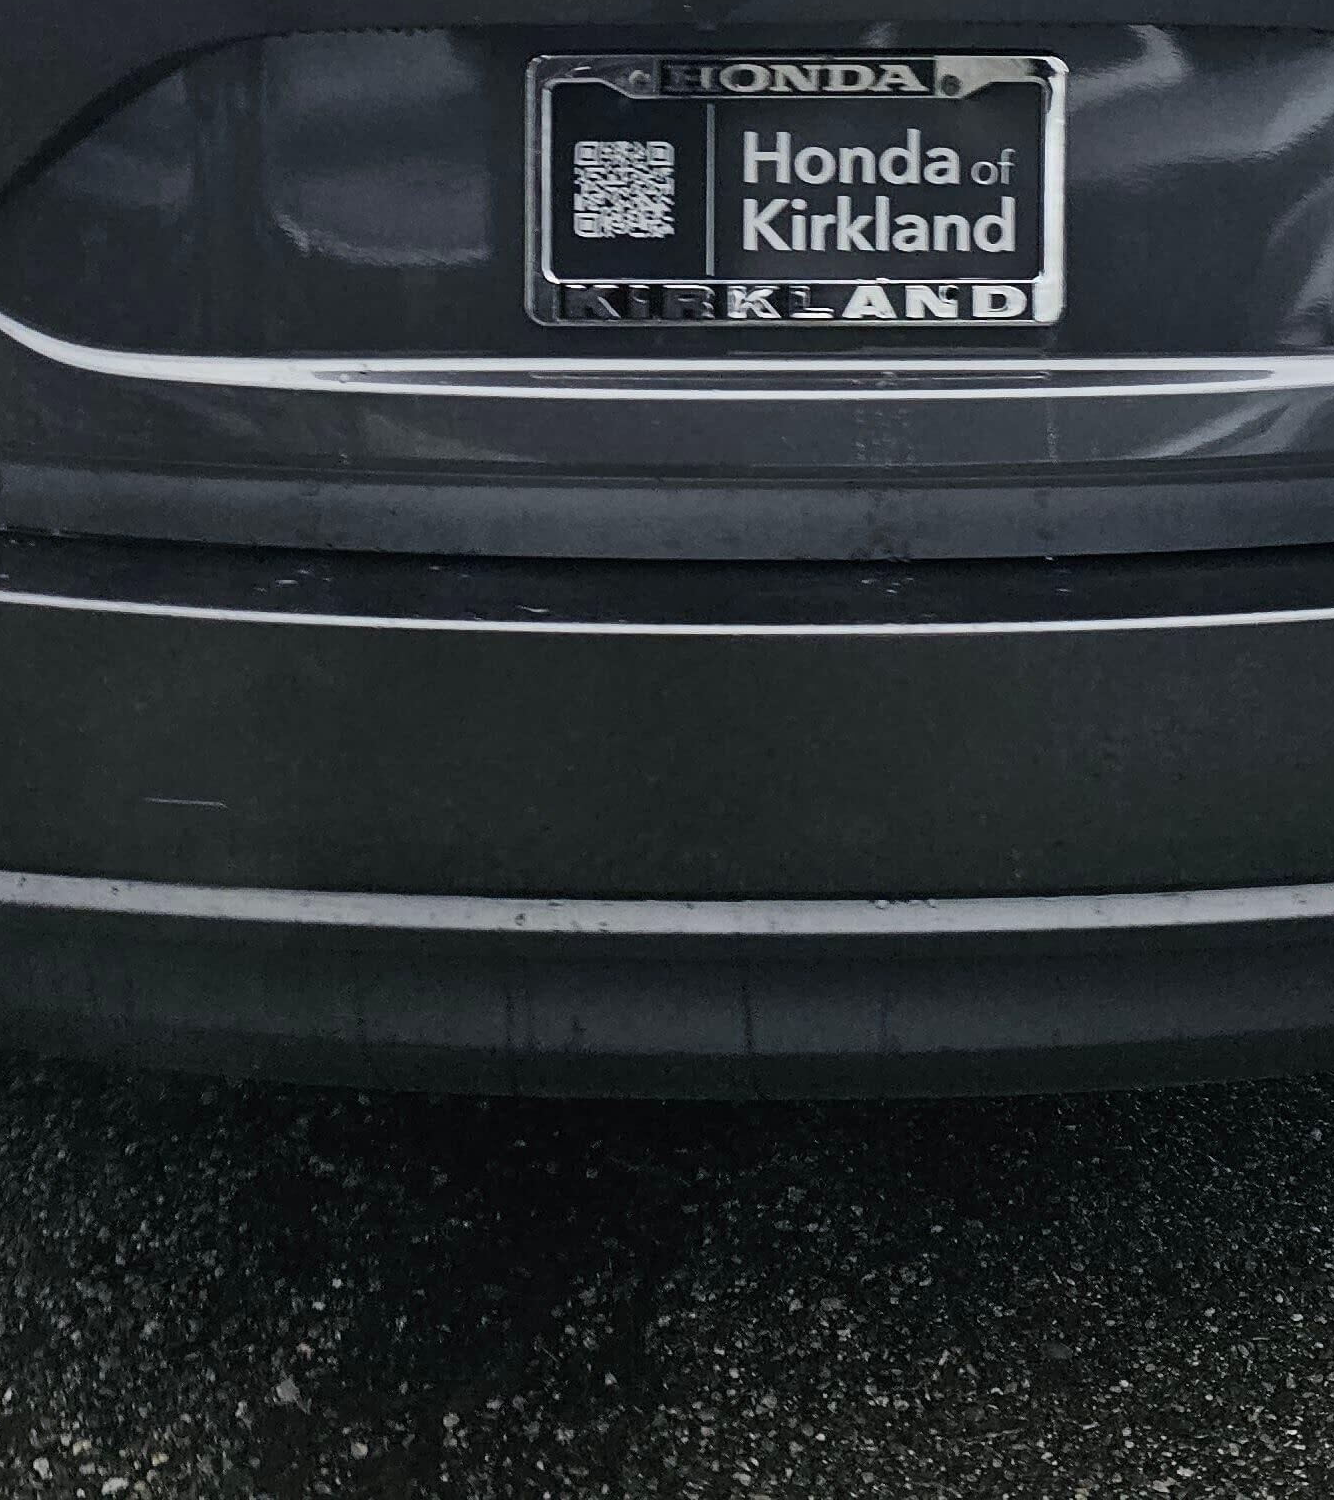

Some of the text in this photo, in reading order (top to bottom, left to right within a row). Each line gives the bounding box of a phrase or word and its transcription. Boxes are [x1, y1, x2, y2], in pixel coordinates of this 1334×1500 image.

[666, 62, 930, 93] HONDA
[742, 128, 1016, 186] Honda of
[742, 196, 1016, 253] Kirkland
[563, 284, 1029, 320] KIRKLAND
